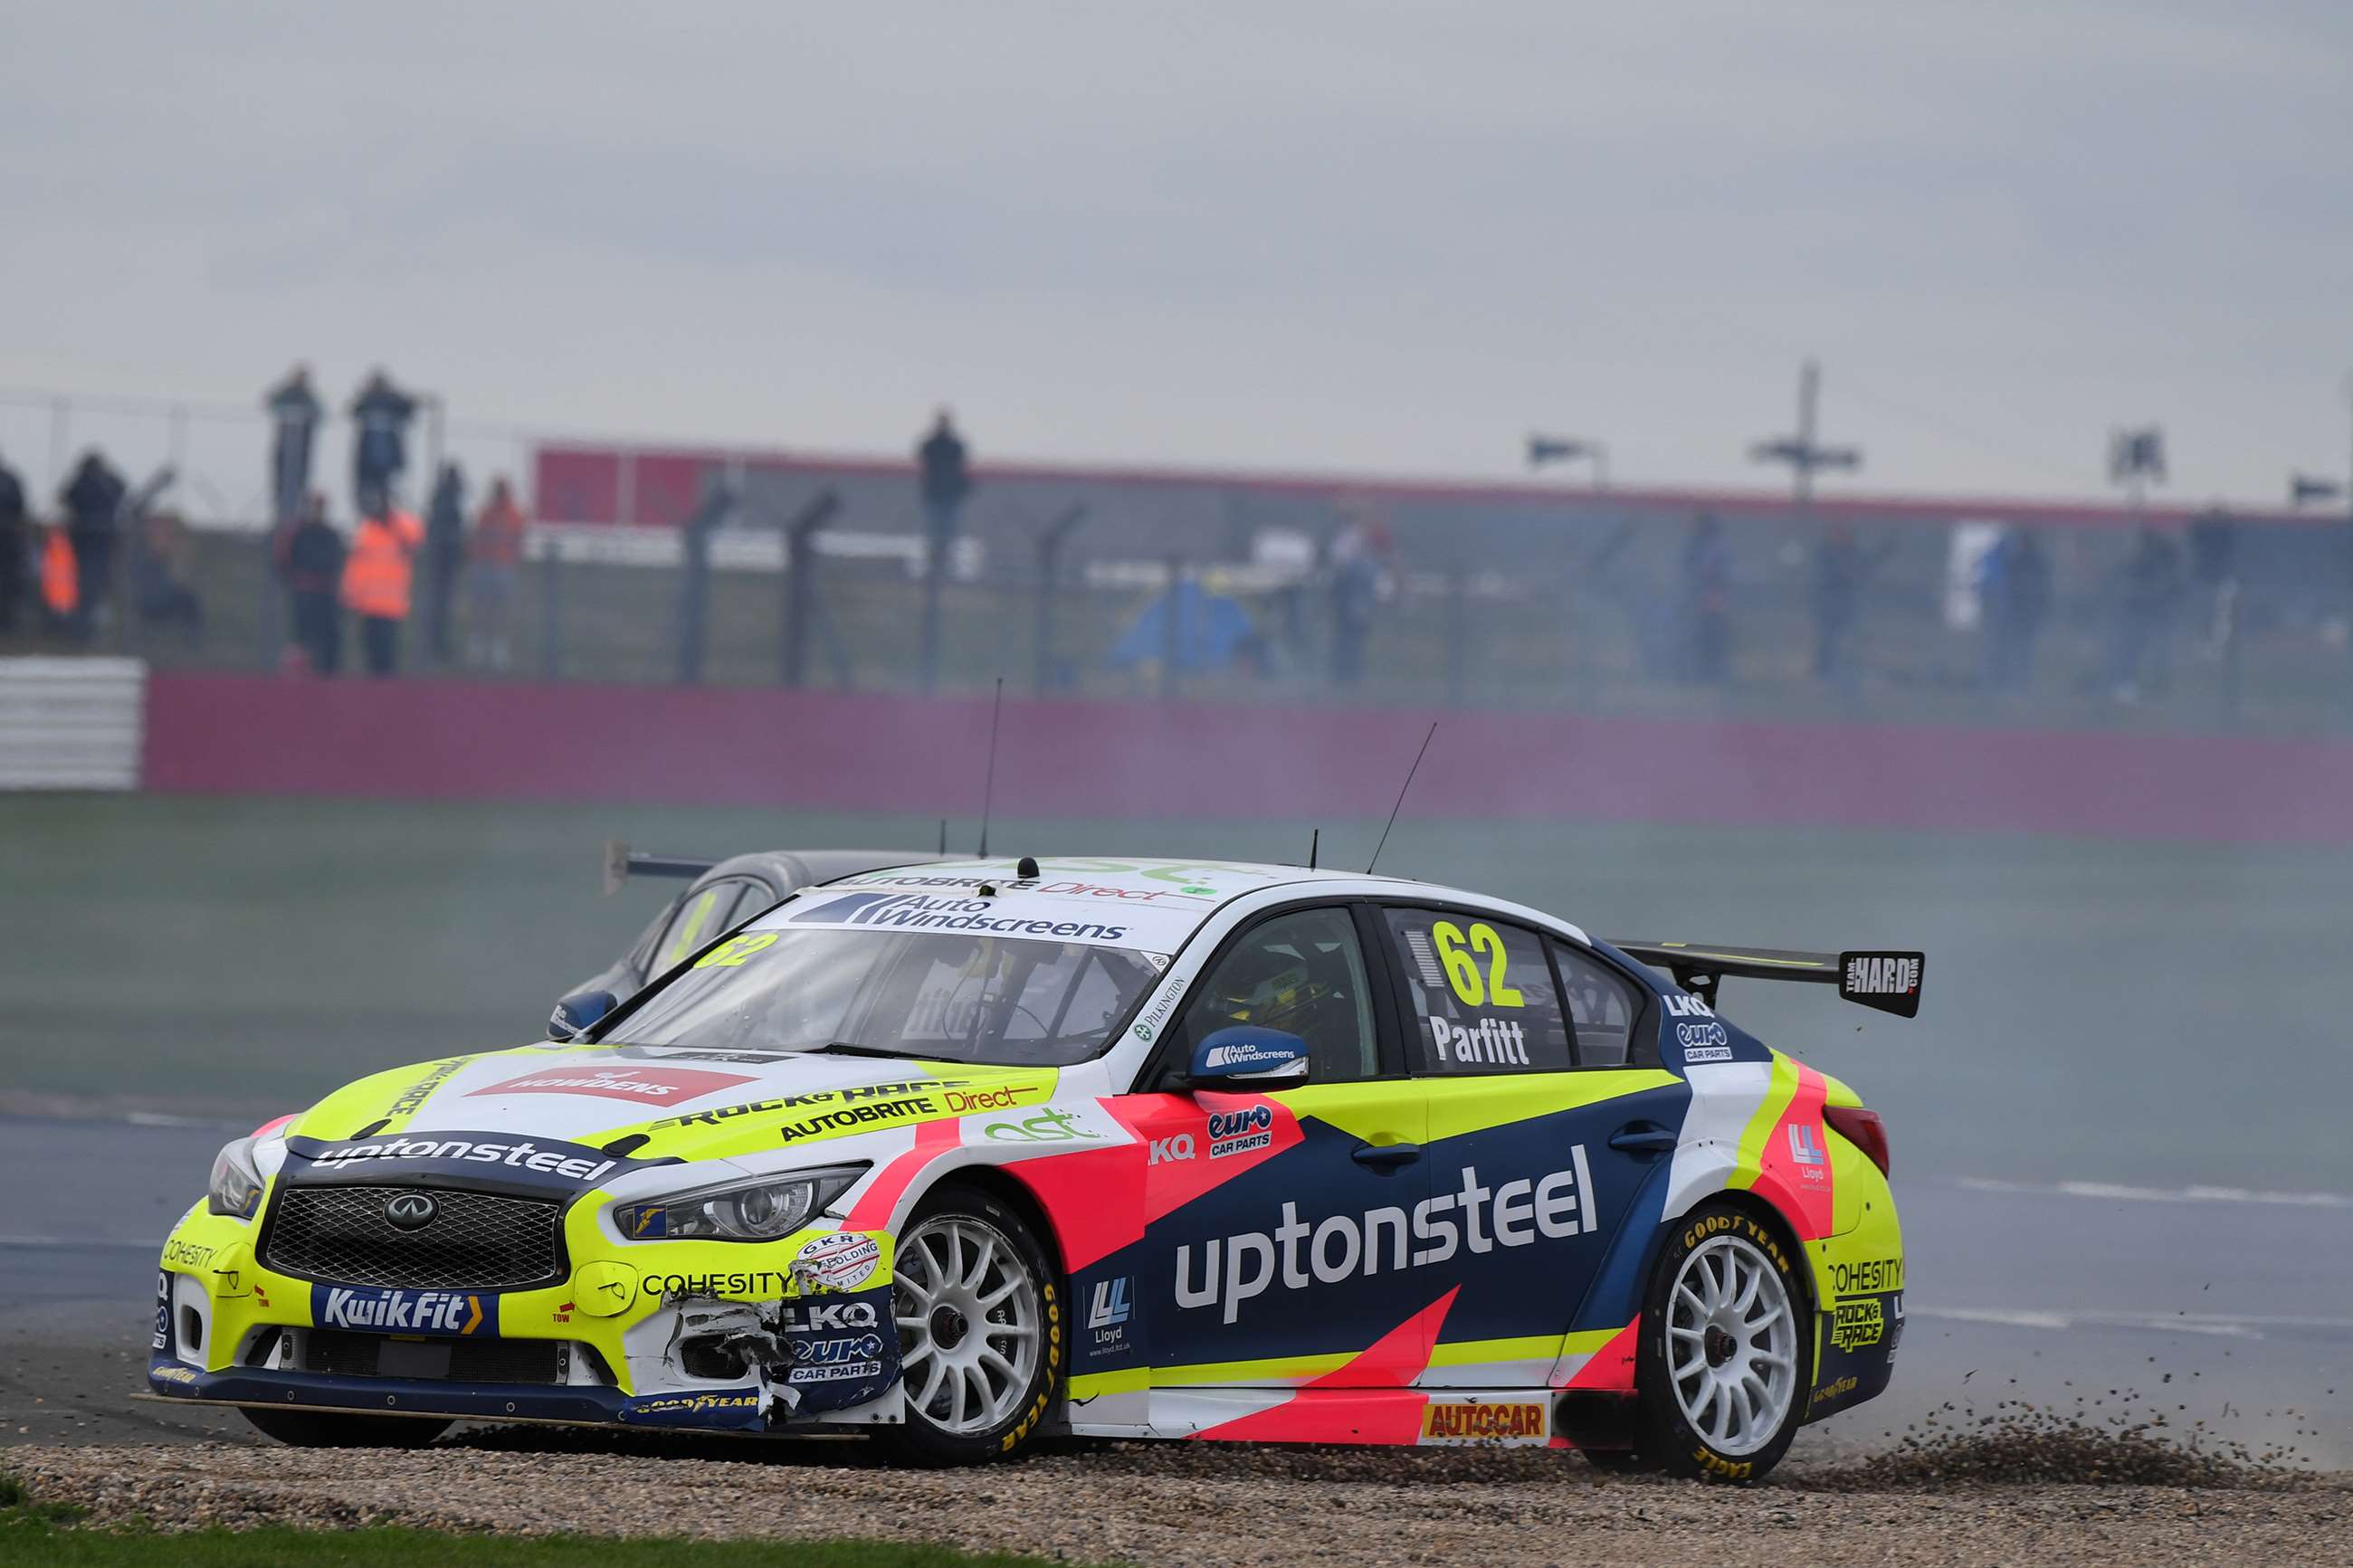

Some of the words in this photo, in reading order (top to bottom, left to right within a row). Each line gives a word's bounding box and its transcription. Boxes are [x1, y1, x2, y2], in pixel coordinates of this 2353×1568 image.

[892, 895, 991, 912] Auto
[1038, 881, 1215, 903] Direct
[872, 909, 1127, 940] Windscreens
[693, 933, 778, 969] 62
[1433, 921, 1525, 1007] 62
[1853, 957, 1910, 993] HARD
[1144, 976, 1185, 1028] PILKINGTON
[1662, 994, 1715, 1019] LKQ
[1429, 1016, 1529, 1065] Parfitt
[1676, 1022, 1728, 1047] euro
[1229, 1044, 1256, 1054] Auto
[1229, 1050, 1295, 1064] Windscreens
[1687, 1050, 1703, 1060] CAR
[1706, 1049, 1730, 1059] PARTS
[780, 1097, 938, 1142] AUTOBRITE
[944, 1086, 1038, 1112] Direct
[1207, 1104, 1273, 1141] euro
[1148, 1133, 1196, 1165] KQ
[1212, 1143, 1234, 1156] CAR
[1236, 1134, 1270, 1151] PARTS
[311, 1138, 616, 1181] uptonsteel
[803, 1234, 853, 1255] GKR
[1175, 1144, 1597, 1325] uptonsteel
[164, 1240, 218, 1269] COHESITY
[643, 1272, 794, 1297] COHESITY
[553, 1314, 570, 1324] TOW
[782, 1302, 879, 1333] LKQ
[1095, 1326, 1122, 1344] Lloyd
[1834, 1323, 1881, 1350] RACE
[793, 1369, 826, 1380] CAR
[831, 1363, 880, 1378] PARTS
[1429, 1404, 1542, 1437] AUTOCAR
